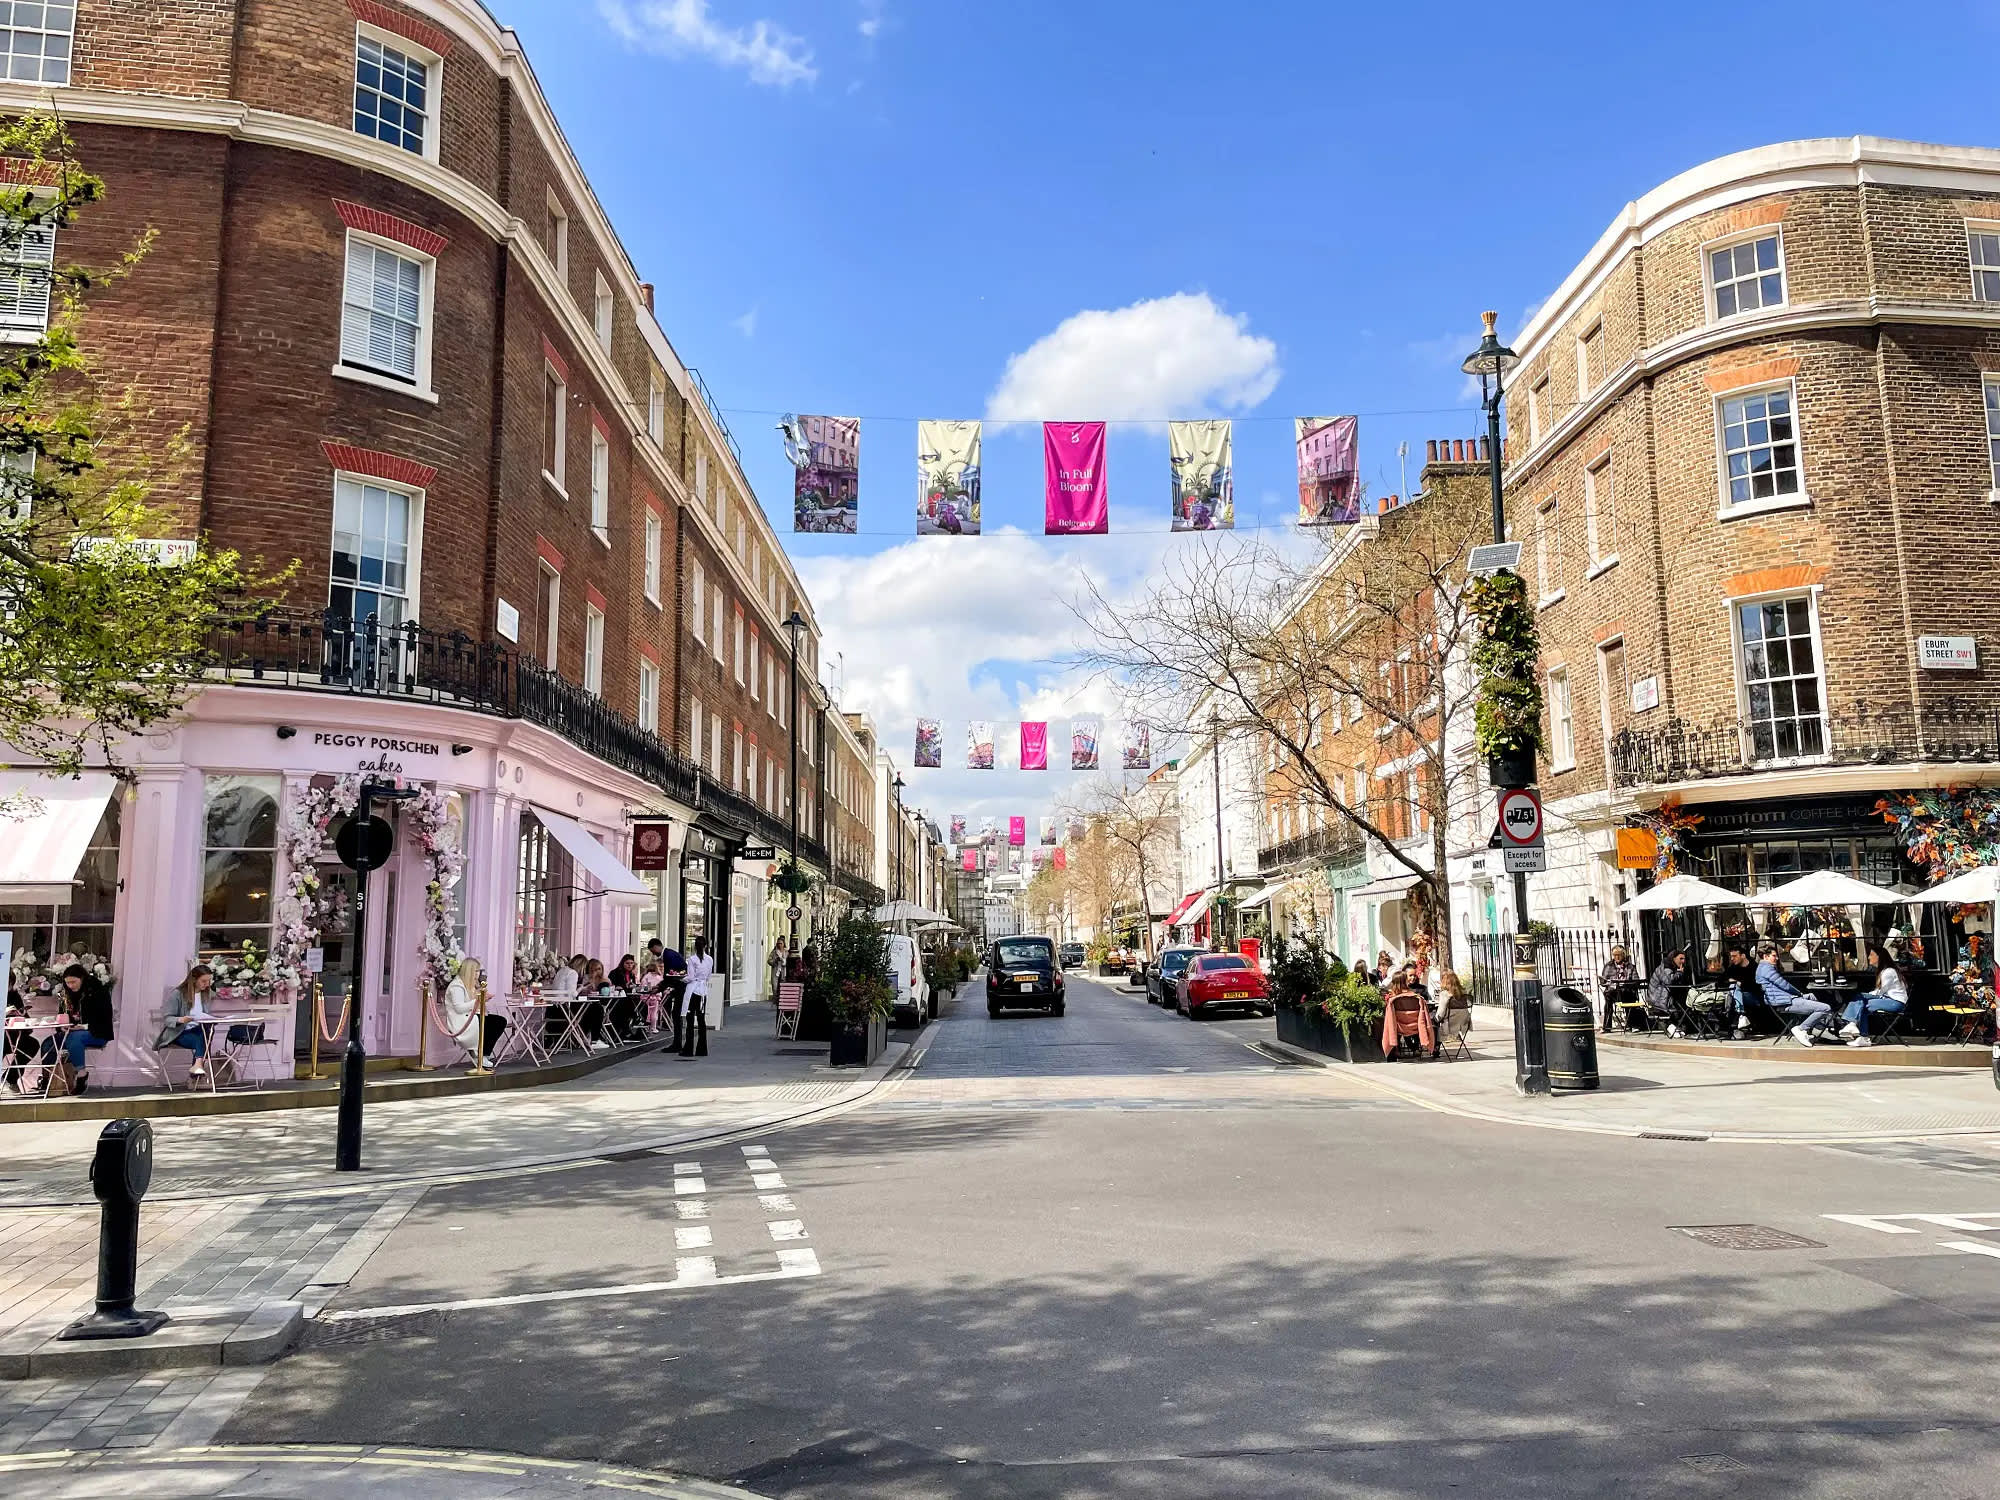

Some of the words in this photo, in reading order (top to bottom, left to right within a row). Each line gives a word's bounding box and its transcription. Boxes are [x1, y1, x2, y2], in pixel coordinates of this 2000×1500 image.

[1060, 470, 1070, 479] In
[1073, 469, 1093, 479] Full
[1060, 482, 1093, 492] Bloom
[1925, 640, 1950, 648] EBURY
[1926, 650, 1954, 658] STREET
[1956, 650, 1972, 658] SW1
[315, 733, 366, 747] PEGGY
[371, 737, 439, 756] PORSCHEN
[358, 753, 403, 773] cakes
[1790, 807, 1843, 820] COFFEE
[1507, 851, 1531, 859] Except
[1532, 850, 1542, 858] for
[136, 1139, 147, 1156] 10
